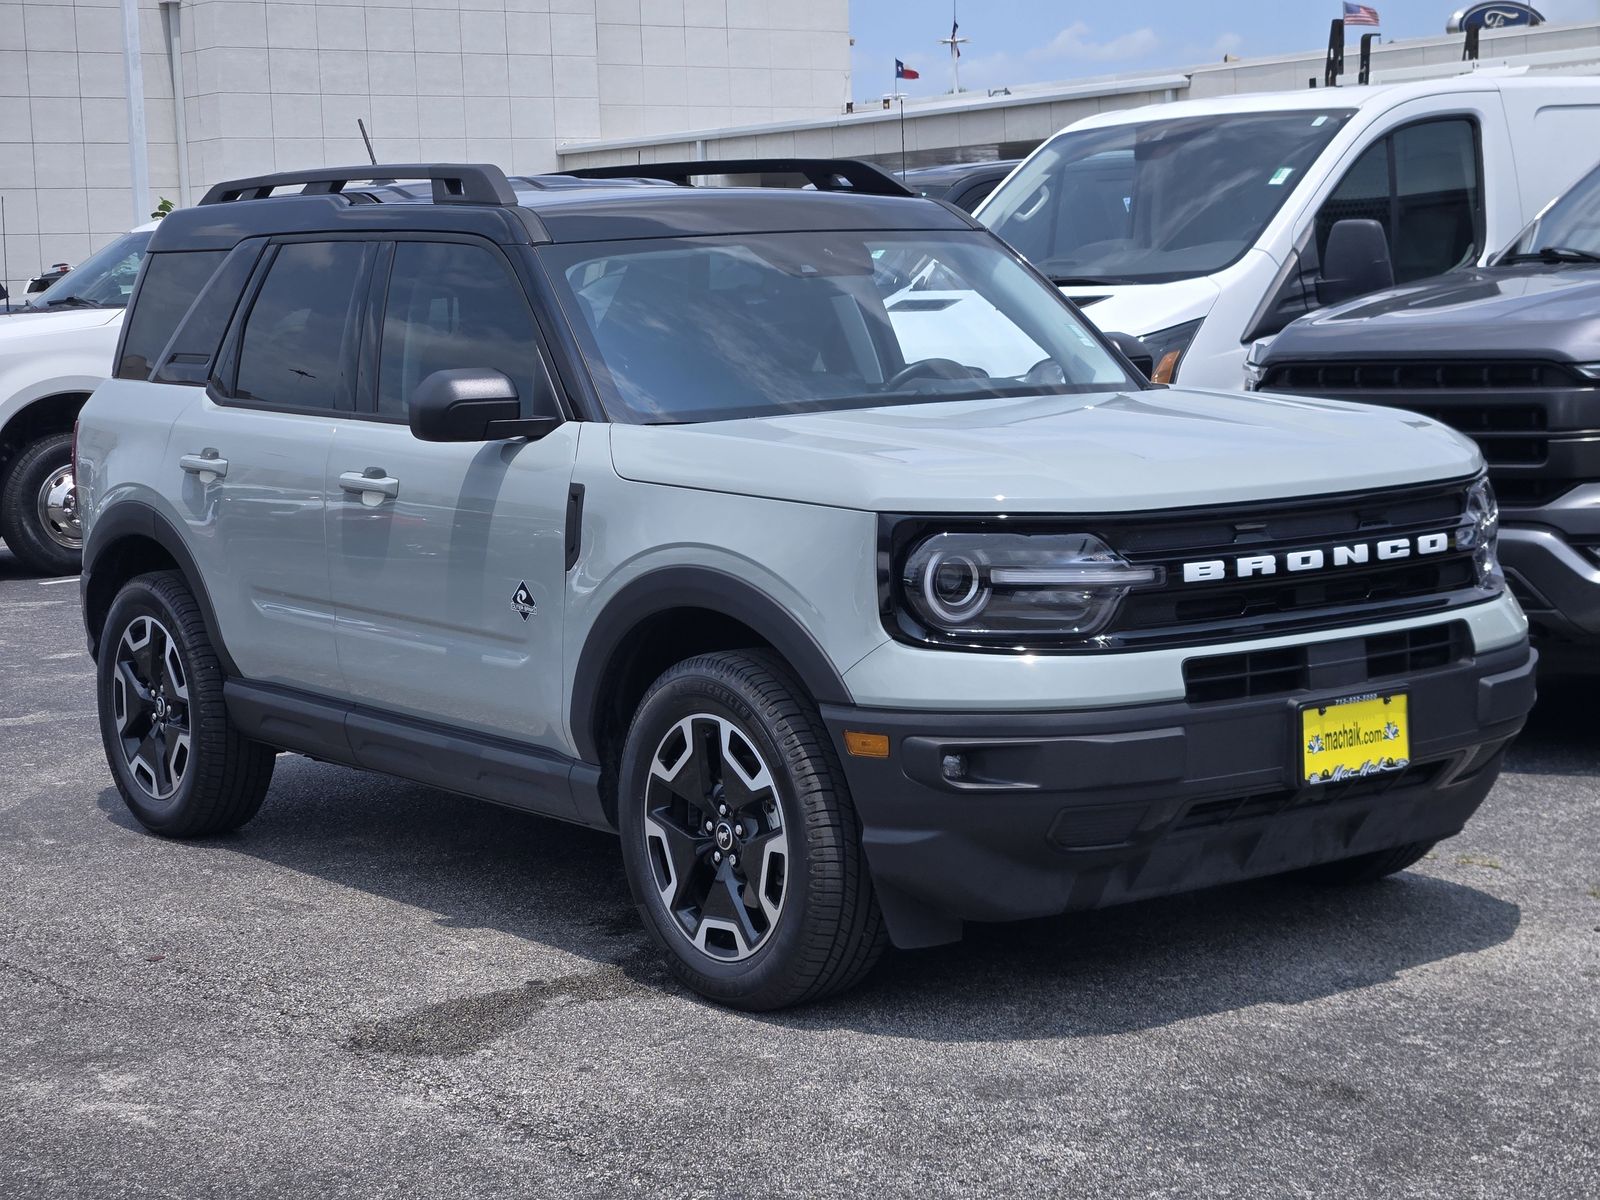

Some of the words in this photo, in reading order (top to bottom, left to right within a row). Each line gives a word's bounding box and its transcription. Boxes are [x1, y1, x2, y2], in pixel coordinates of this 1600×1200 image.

[1183, 533, 1448, 582] BRONCO
[1324, 722, 1383, 751] machaik.com
[1331, 764, 1357, 782] Mac
[1359, 757, 1388, 776] Haik
